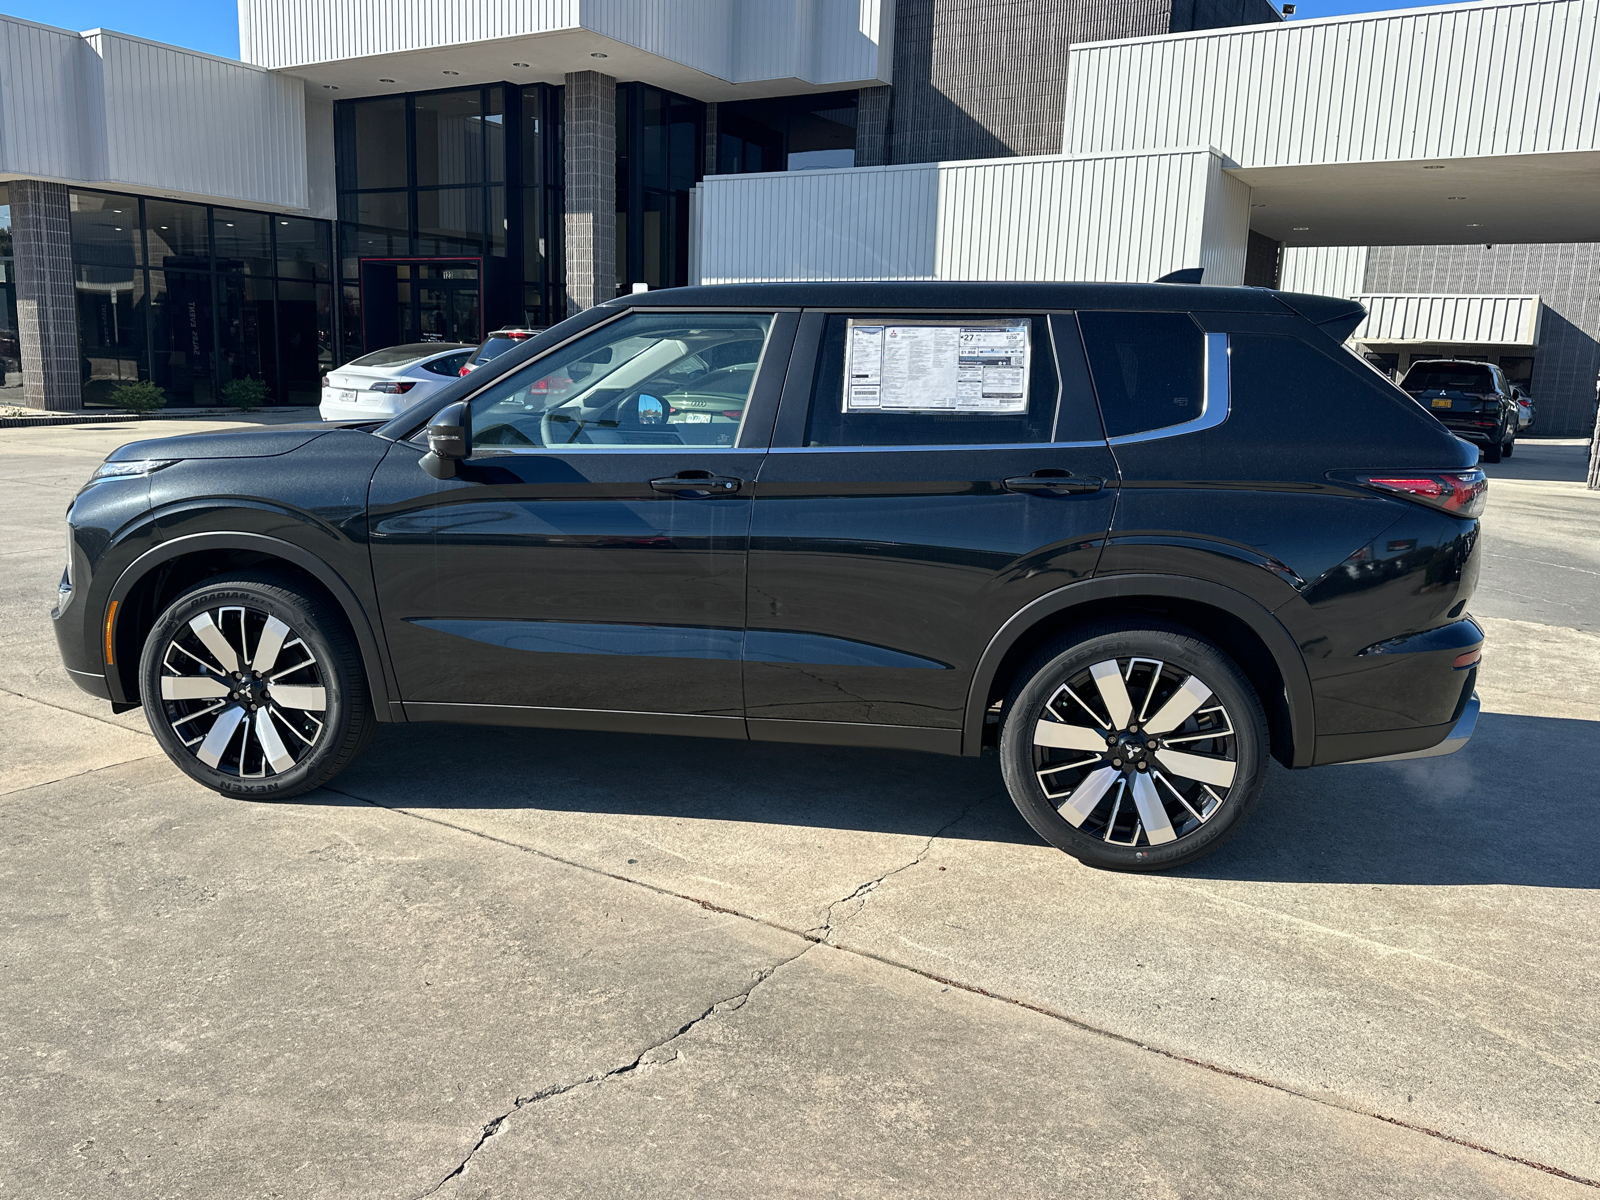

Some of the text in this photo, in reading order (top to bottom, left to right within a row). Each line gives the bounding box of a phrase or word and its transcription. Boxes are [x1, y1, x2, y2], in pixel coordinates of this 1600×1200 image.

[1060, 641, 1131, 671] NEXEN
[219, 780, 280, 793] NEXEN
[1152, 826, 1220, 863] ROADIAN
